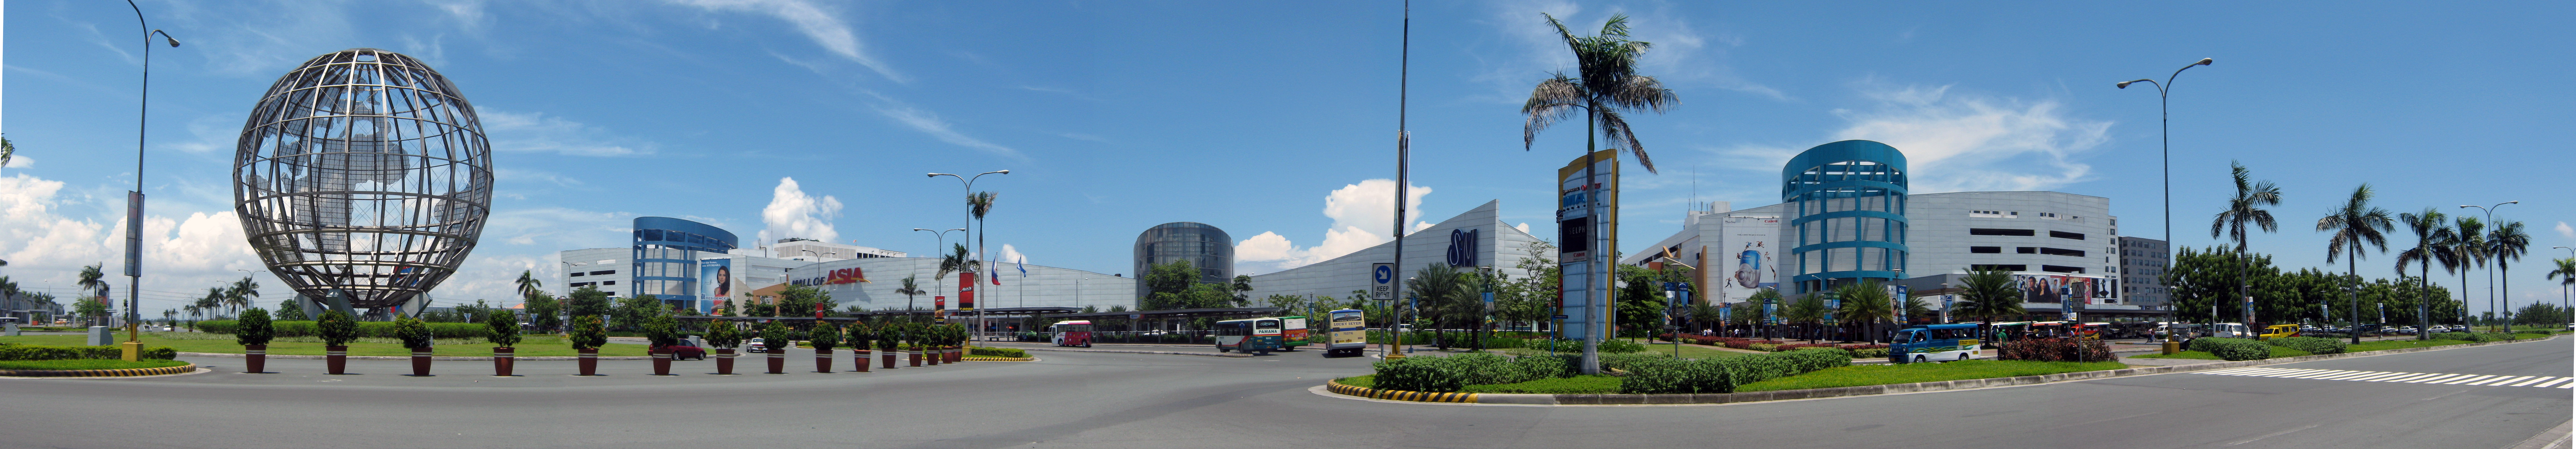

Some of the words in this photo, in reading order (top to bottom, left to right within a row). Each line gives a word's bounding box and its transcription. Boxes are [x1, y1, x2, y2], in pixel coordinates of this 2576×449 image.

[1569, 226, 1587, 234] SELPH
[1447, 229, 1477, 267] SM
[792, 278, 811, 287] MALL
[813, 277, 825, 286] OF
[826, 267, 866, 285] ASIA
